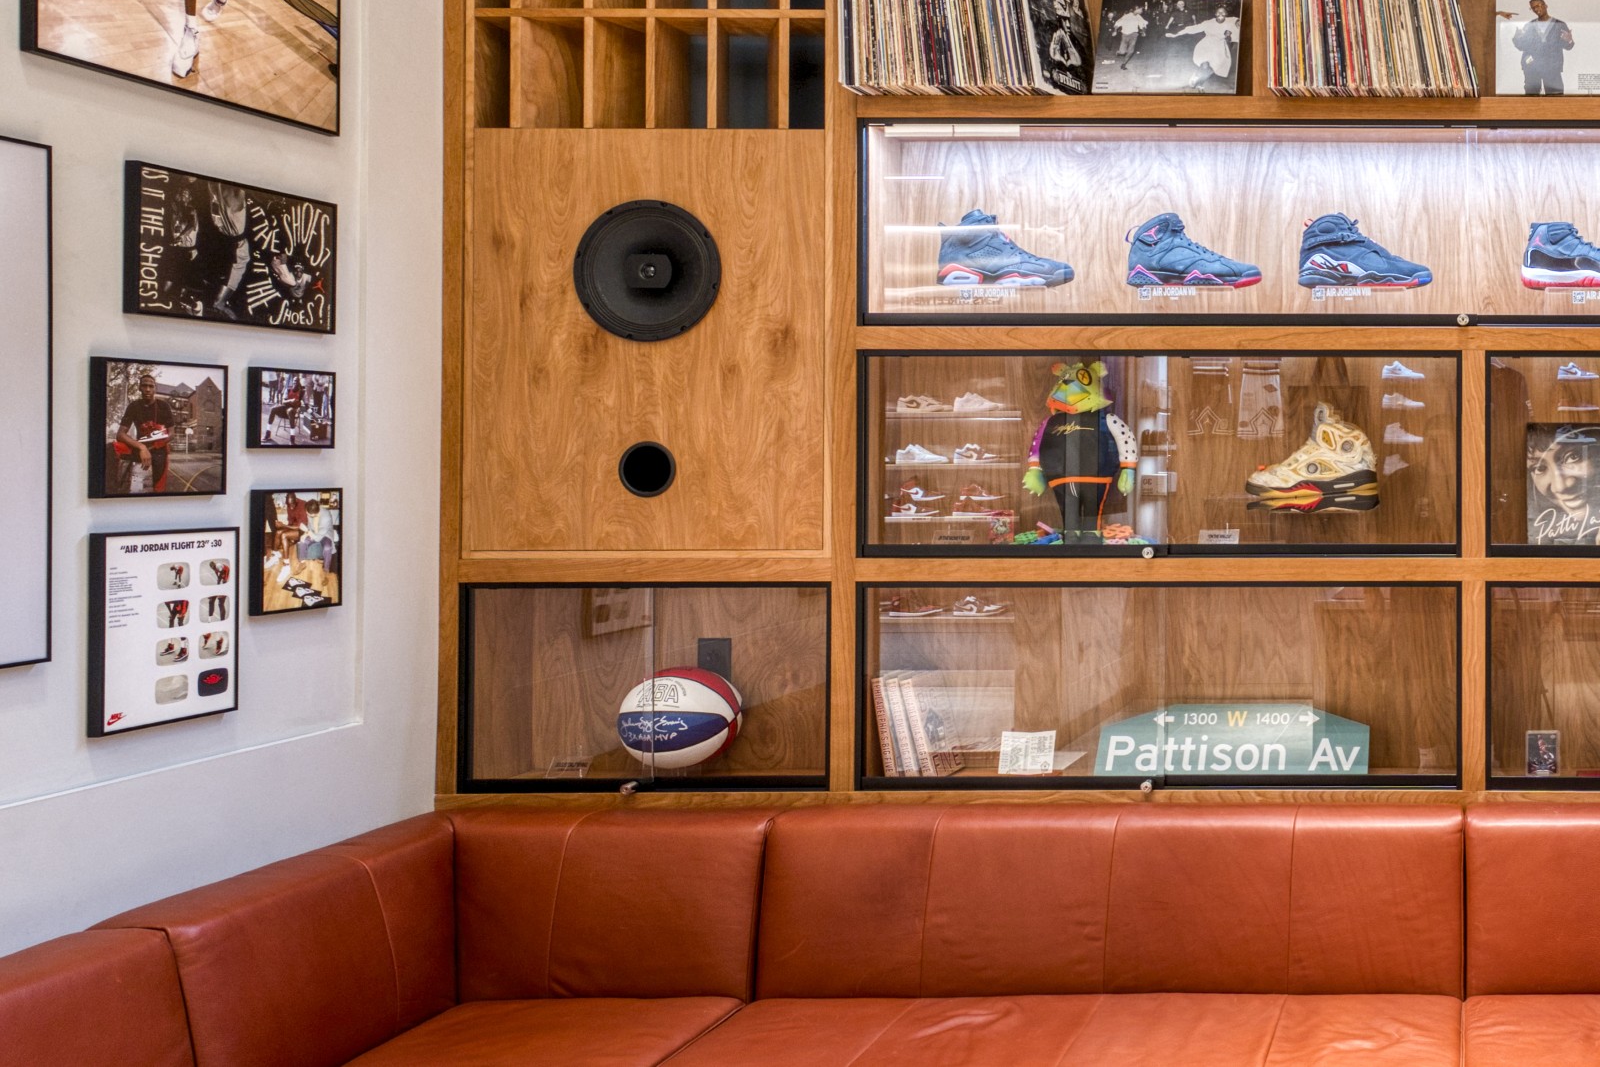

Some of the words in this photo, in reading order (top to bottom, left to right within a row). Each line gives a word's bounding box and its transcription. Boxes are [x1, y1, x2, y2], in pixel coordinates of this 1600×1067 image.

[141, 186, 166, 201] IT
[140, 206, 165, 237] THE
[252, 219, 281, 253] THE
[246, 276, 281, 316] THE
[973, 288, 985, 297] AIR
[986, 288, 1009, 297] JORDAN
[1152, 287, 1163, 296] AIR
[1163, 287, 1188, 296] JORDAN
[1326, 288, 1337, 296] AIR
[1337, 288, 1361, 296] JORDAN
[1586, 291, 1597, 300] AIR
[1534, 508, 1585, 545] Patti
[139, 542, 170, 553] JORDAN
[170, 540, 195, 551] FLIGHT
[210, 539, 222, 548] :30
[1183, 712, 1218, 725] 1300
[1226, 710, 1248, 728] W
[1255, 712, 1290, 725] 1400
[1104, 734, 1287, 772] Pattison
[1307, 737, 1361, 772] Av
